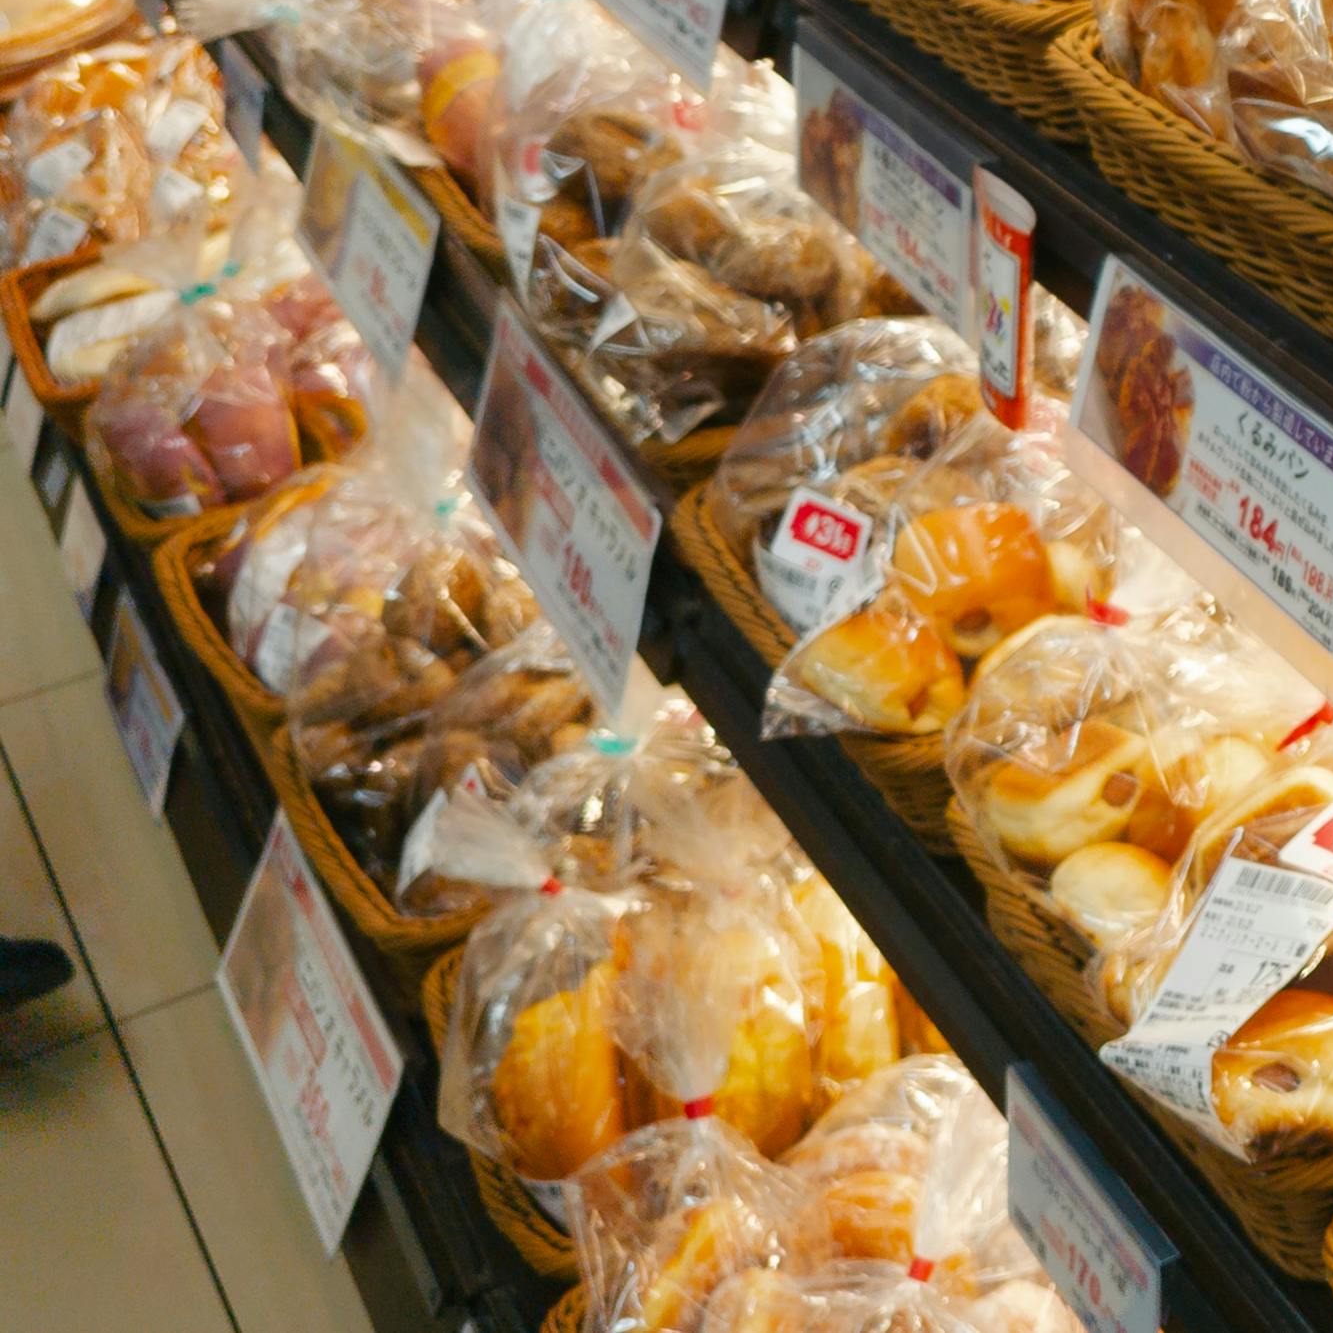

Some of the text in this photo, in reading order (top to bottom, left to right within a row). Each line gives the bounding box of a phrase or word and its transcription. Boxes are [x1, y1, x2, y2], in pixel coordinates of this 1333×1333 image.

[1238, 411, 1309, 479] くるみパン
